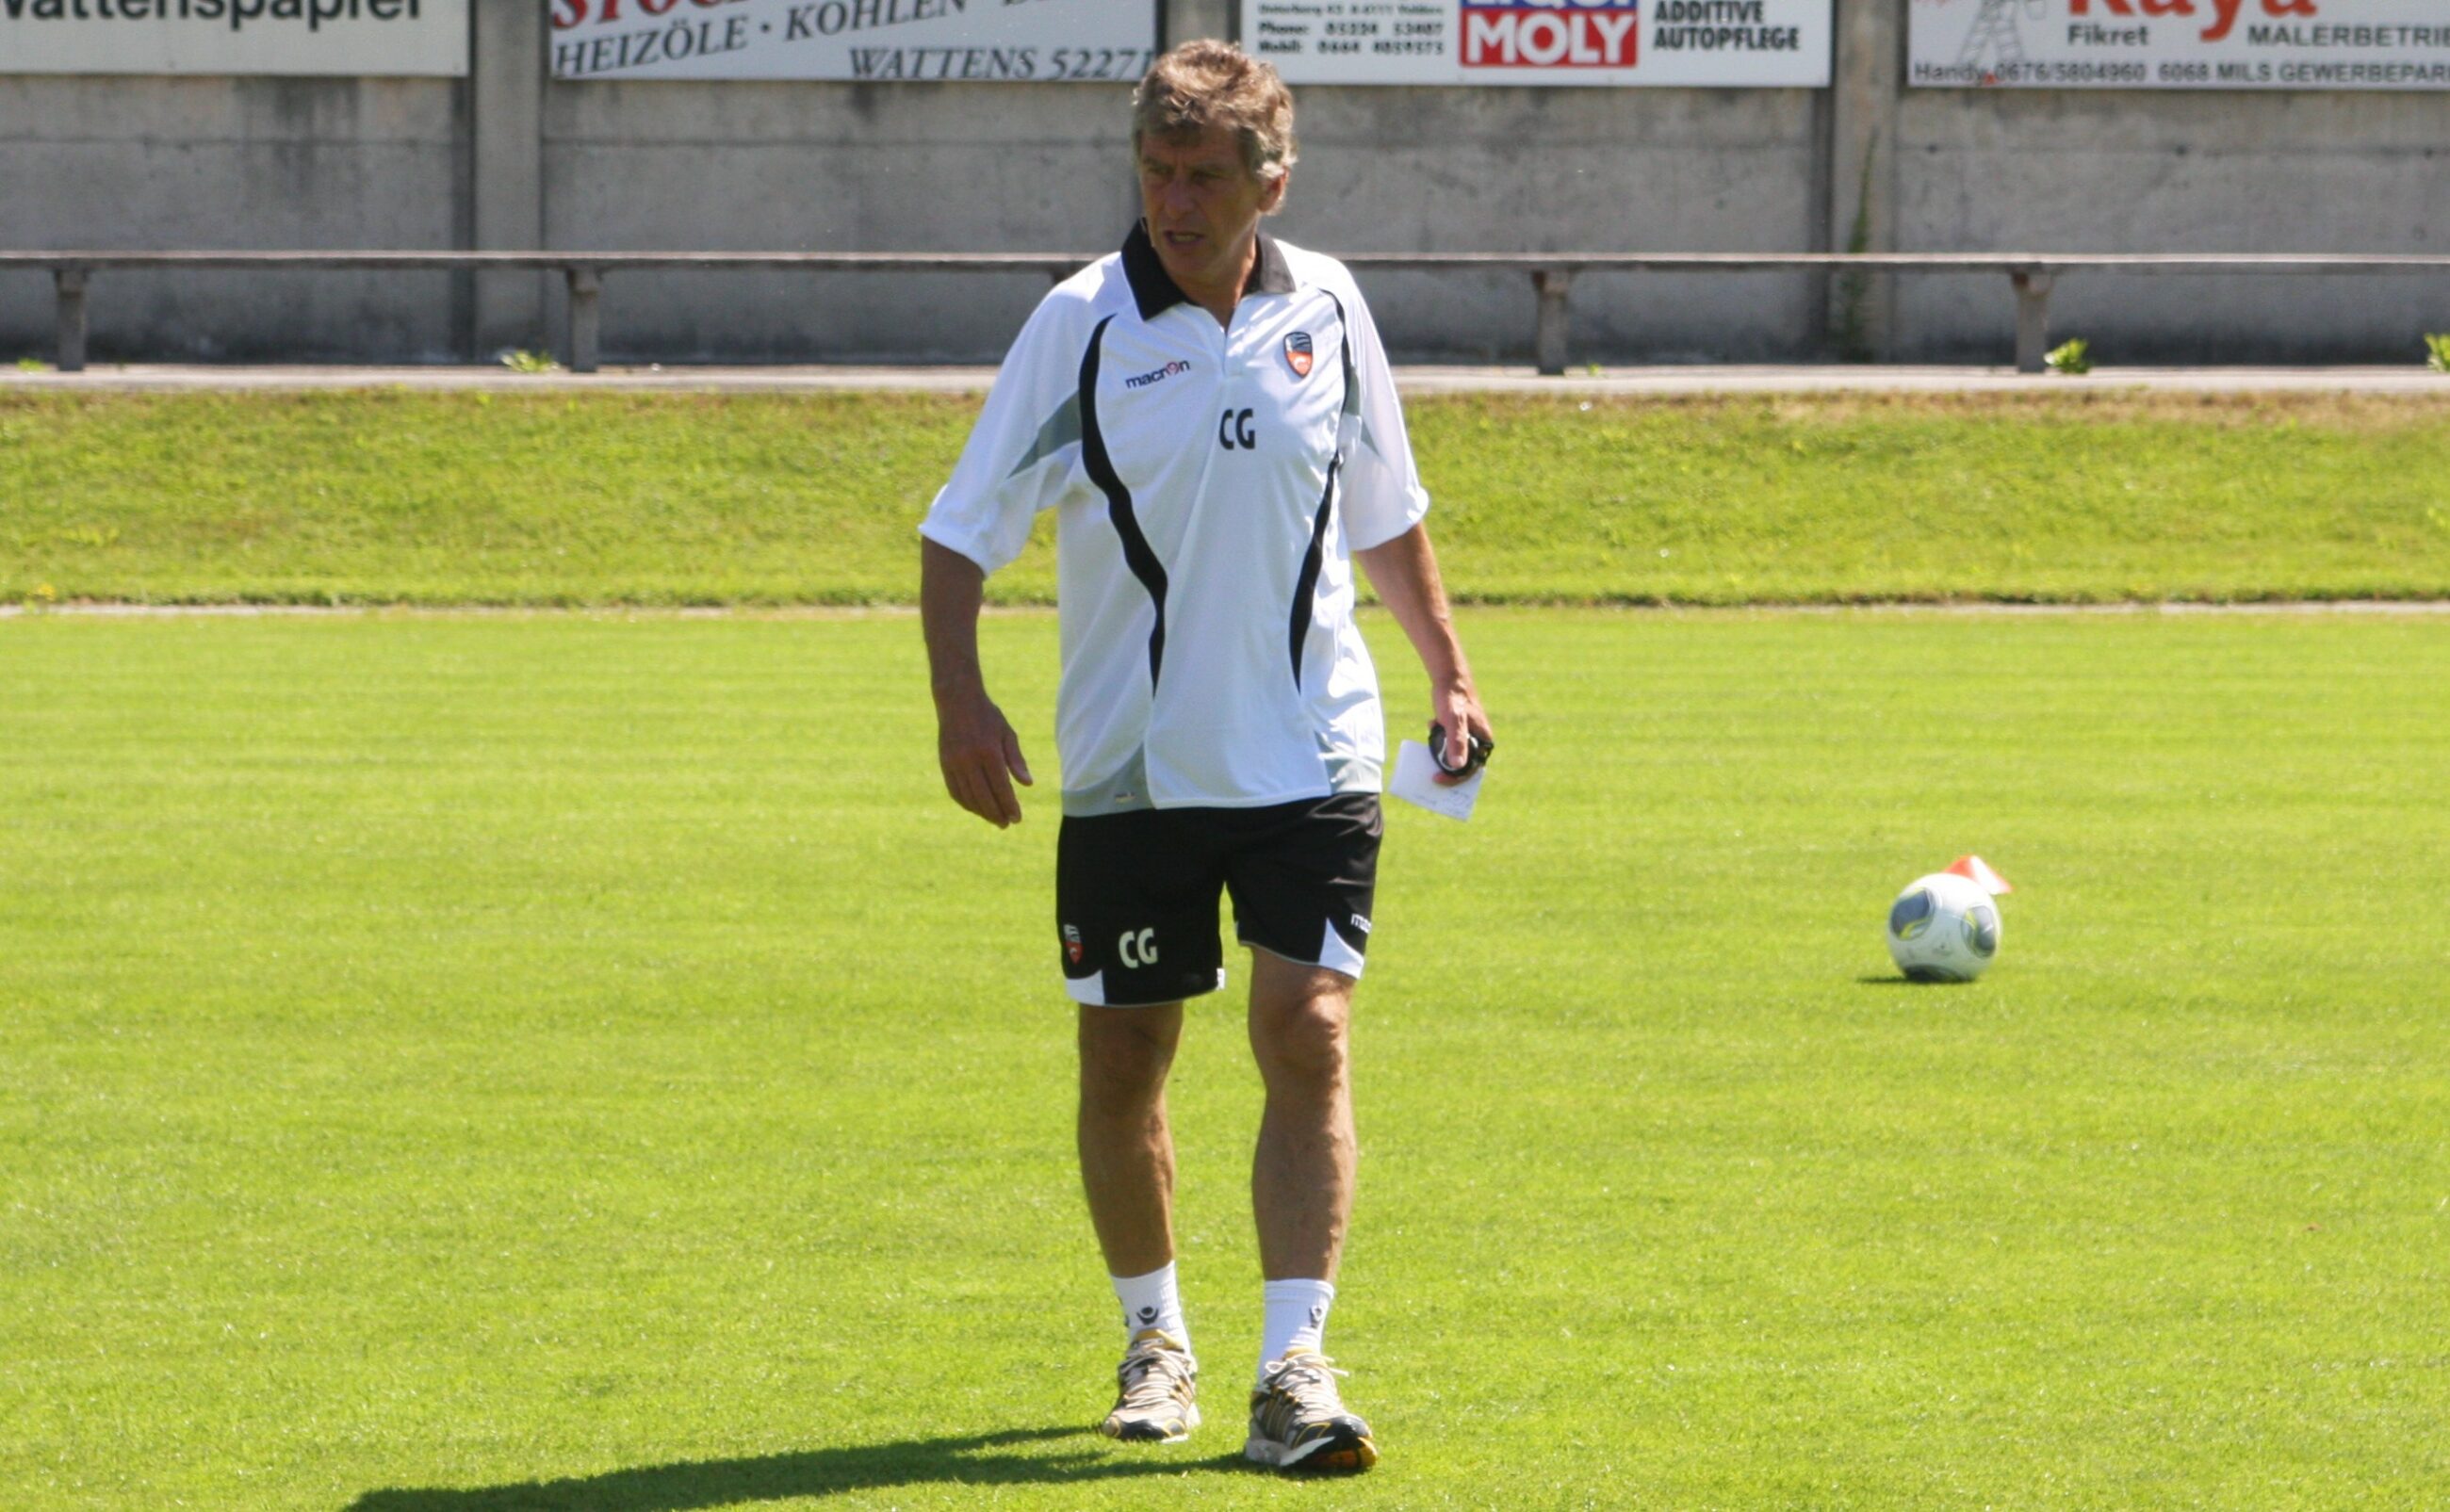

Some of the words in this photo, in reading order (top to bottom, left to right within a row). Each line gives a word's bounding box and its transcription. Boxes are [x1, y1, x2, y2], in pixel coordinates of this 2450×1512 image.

[3, 0, 420, 31] attenspapier
[1655, 0, 1764, 23] ADDITIVE
[556, 15, 750, 74] HEIZÖLE
[1466, 11, 1636, 65] MOLY
[1654, 25, 1801, 50] AUTOPFLEGE
[2067, 24, 2149, 46] Fikret
[849, 47, 1037, 80] WATTENS
[2158, 62, 2211, 82] 6068
[2217, 62, 2272, 82] MILS
[2278, 62, 2450, 82] GEWERBEPAR
[1125, 360, 1191, 389] macron
[1218, 408, 1256, 450] CG
[1119, 927, 1158, 968] CG
